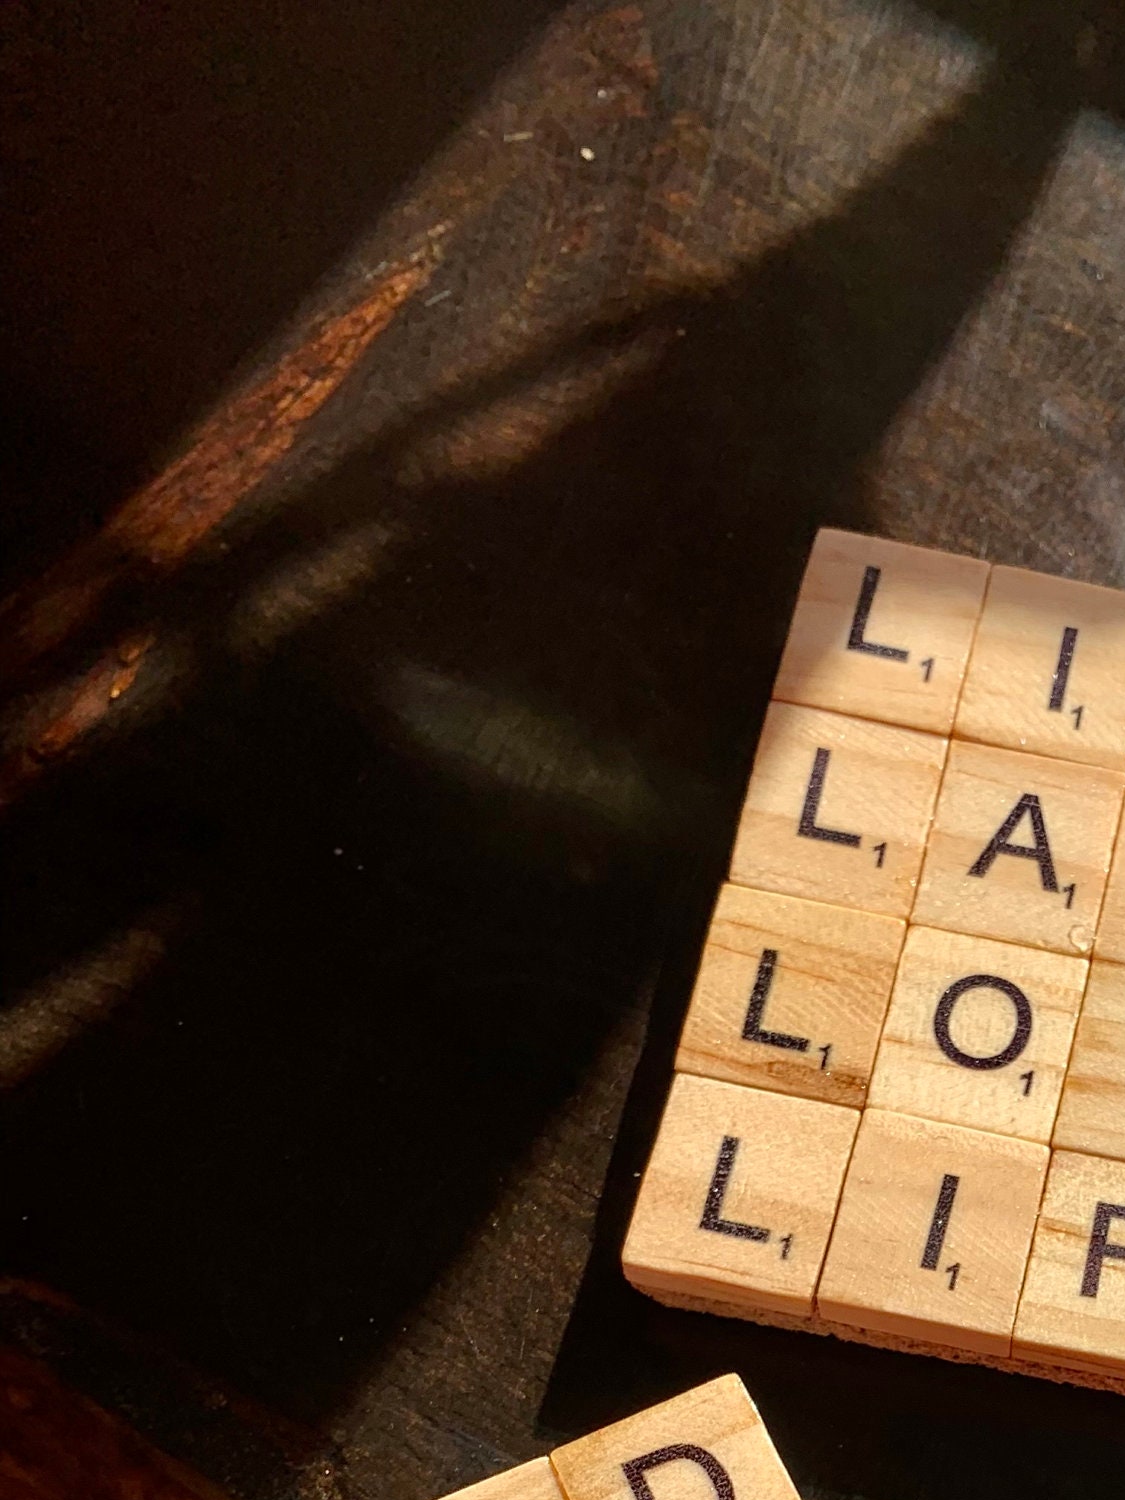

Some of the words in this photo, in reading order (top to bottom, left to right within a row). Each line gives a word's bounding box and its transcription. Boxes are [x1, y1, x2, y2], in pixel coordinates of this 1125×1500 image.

[921, 657, 934, 683] 1
[1071, 705, 1084, 731] 1
[872, 841, 888, 869] 1
[1061, 882, 1077, 910] 1
[818, 1043, 833, 1072] 1
[1019, 1069, 1036, 1098] 1
[779, 1232, 794, 1261] 1
[944, 1262, 962, 1292] 1
